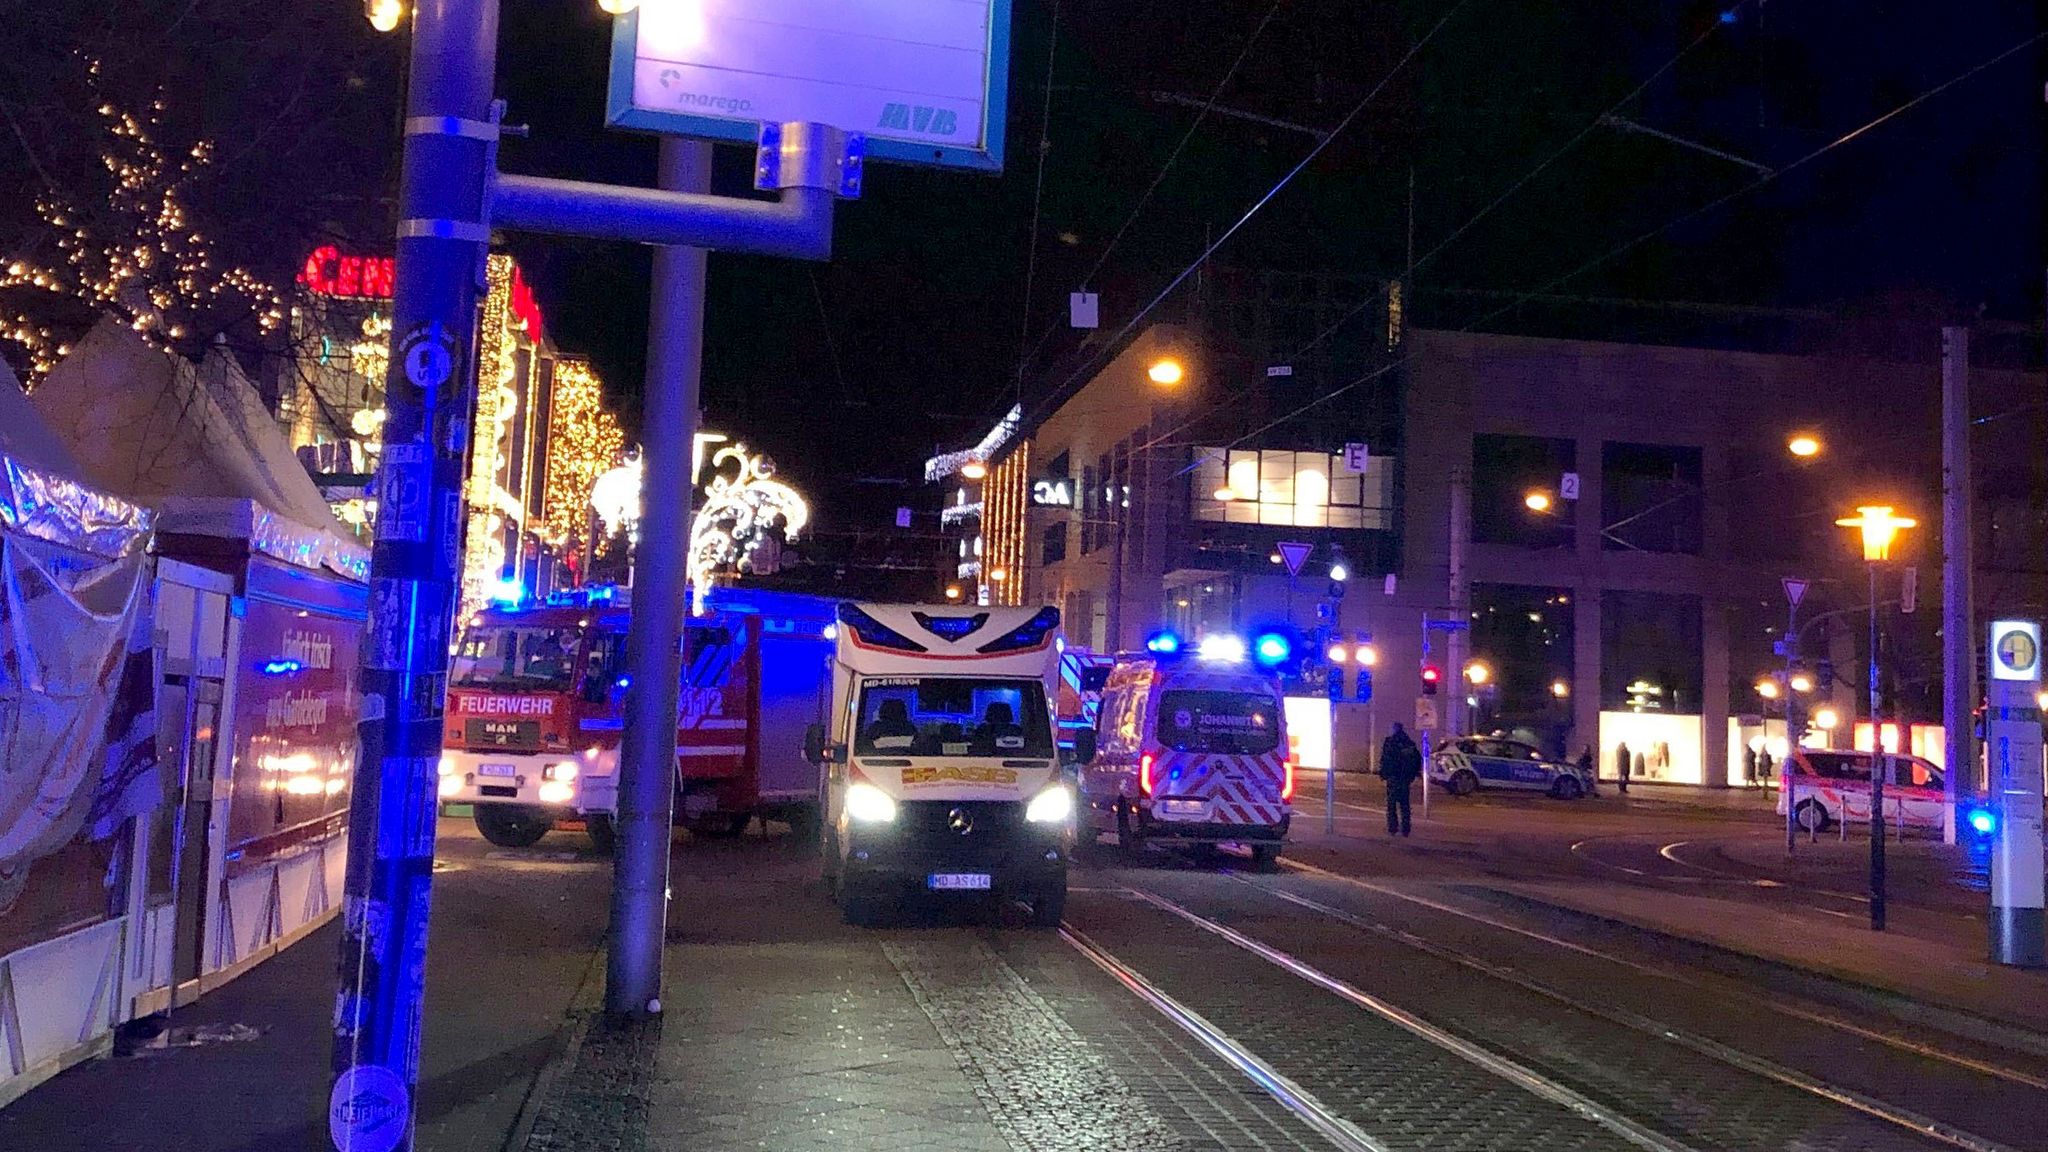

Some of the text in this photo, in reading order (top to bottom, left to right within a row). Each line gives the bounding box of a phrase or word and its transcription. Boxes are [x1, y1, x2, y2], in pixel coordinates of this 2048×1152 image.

[303, 245, 396, 296] CEN
[1565, 478, 1575, 493] 2
[459, 696, 554, 715] FEUERWEHR
[485, 723, 518, 734] MAN
